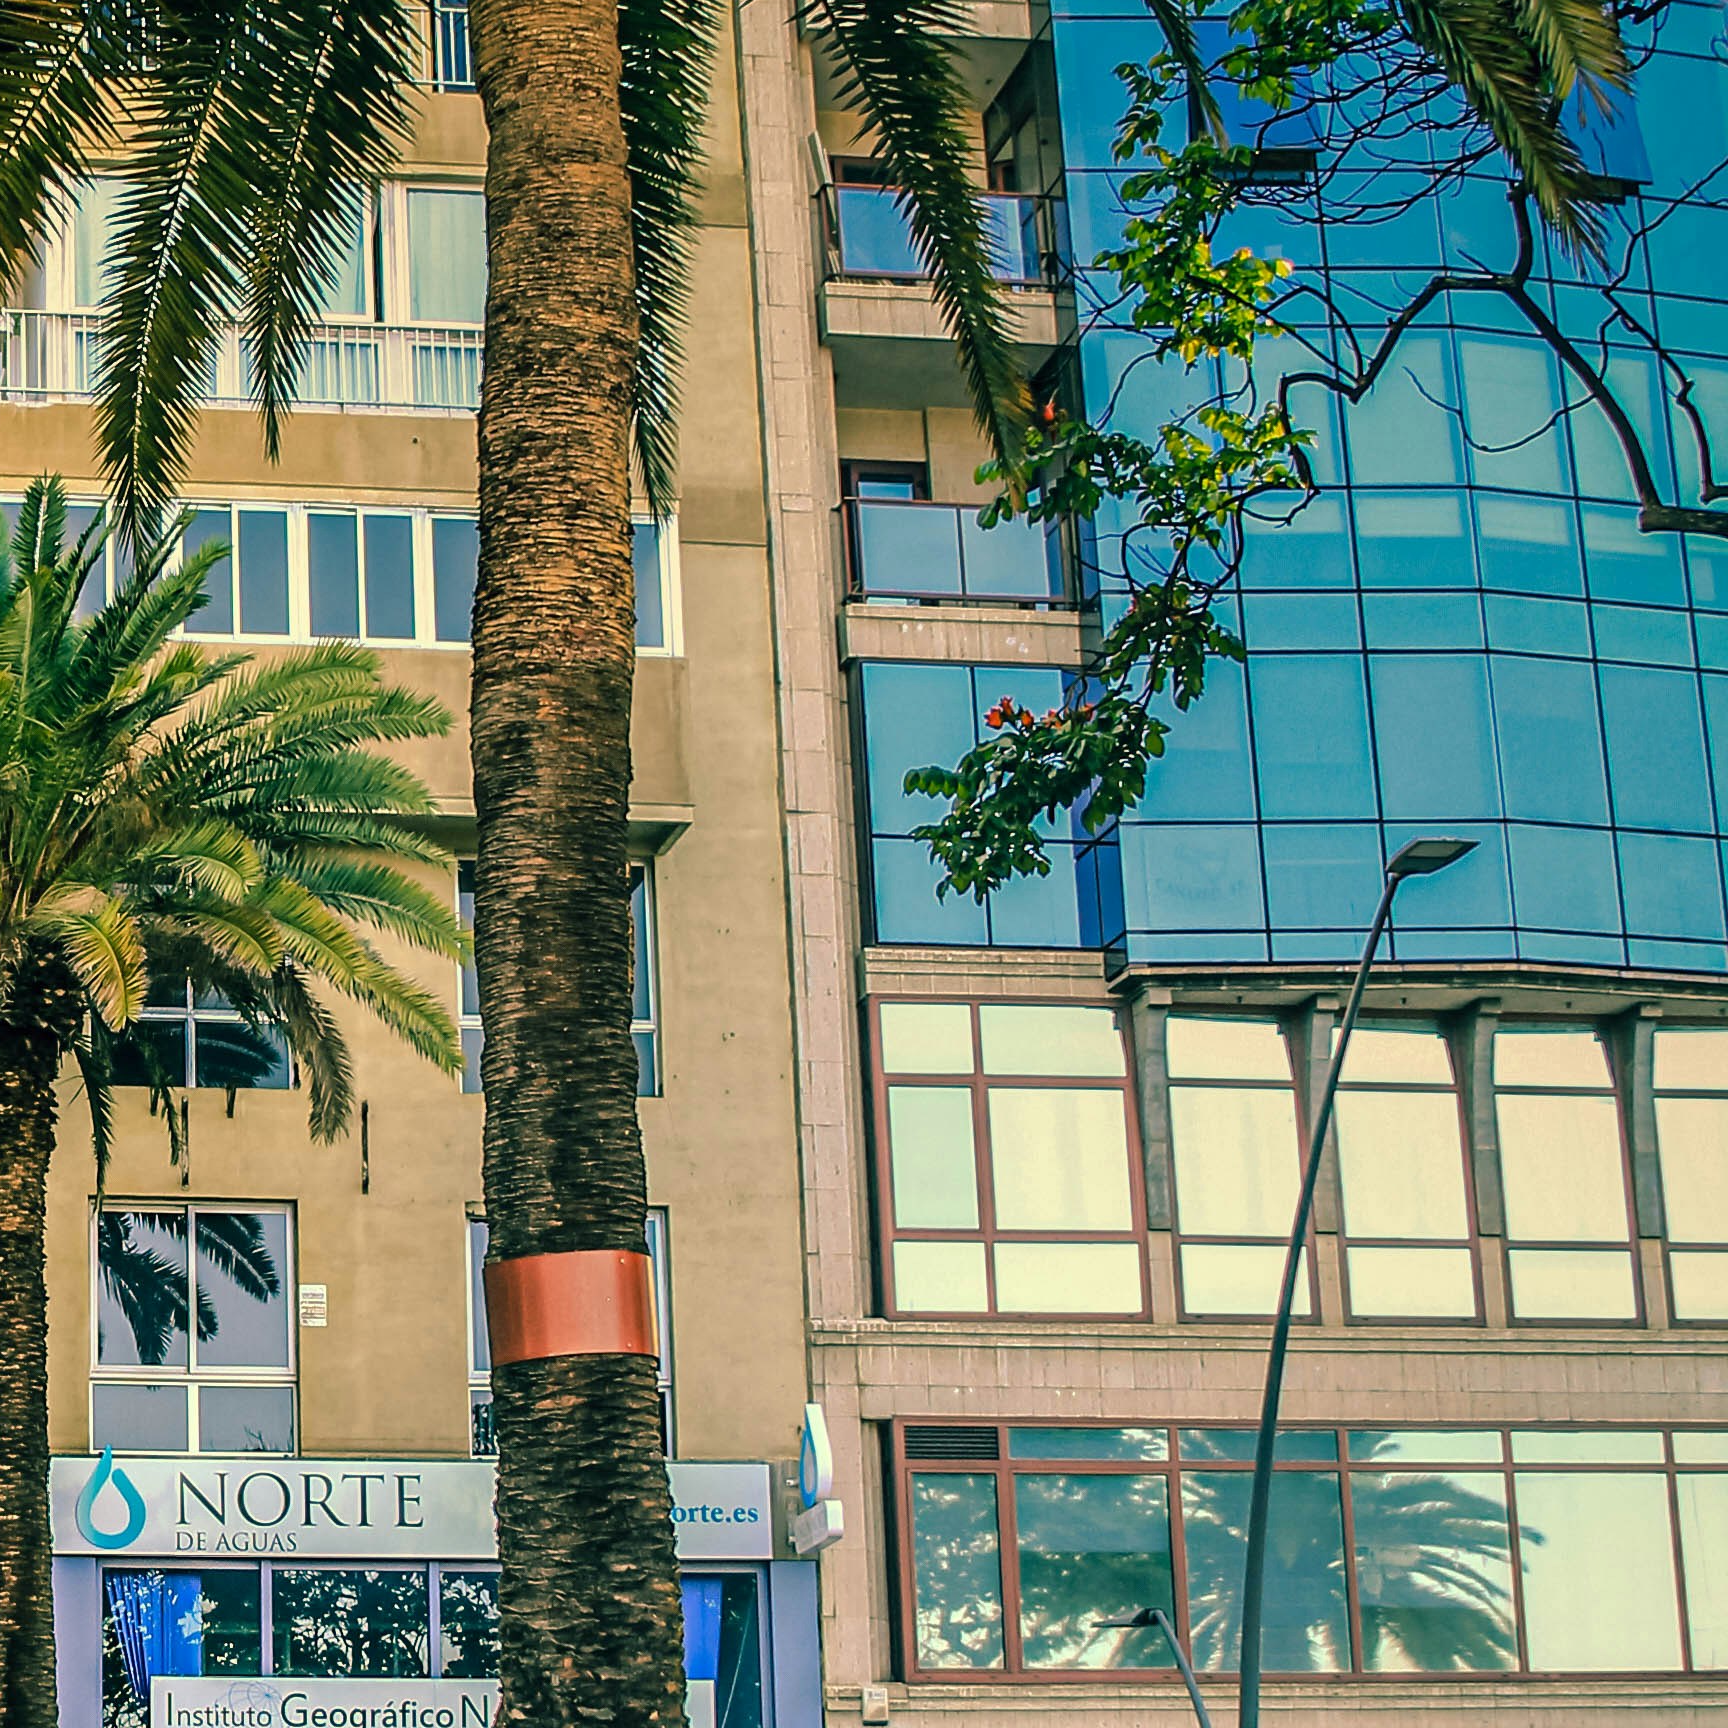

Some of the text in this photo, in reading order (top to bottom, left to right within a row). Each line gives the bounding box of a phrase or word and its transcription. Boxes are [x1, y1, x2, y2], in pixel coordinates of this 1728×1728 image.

[175, 1471, 424, 1528] NORTE
[671, 1504, 759, 1523] orte.es
[175, 1532, 207, 1552] DE
[215, 1532, 297, 1553] AGUAS
[166, 1692, 272, 1728] Instituto
